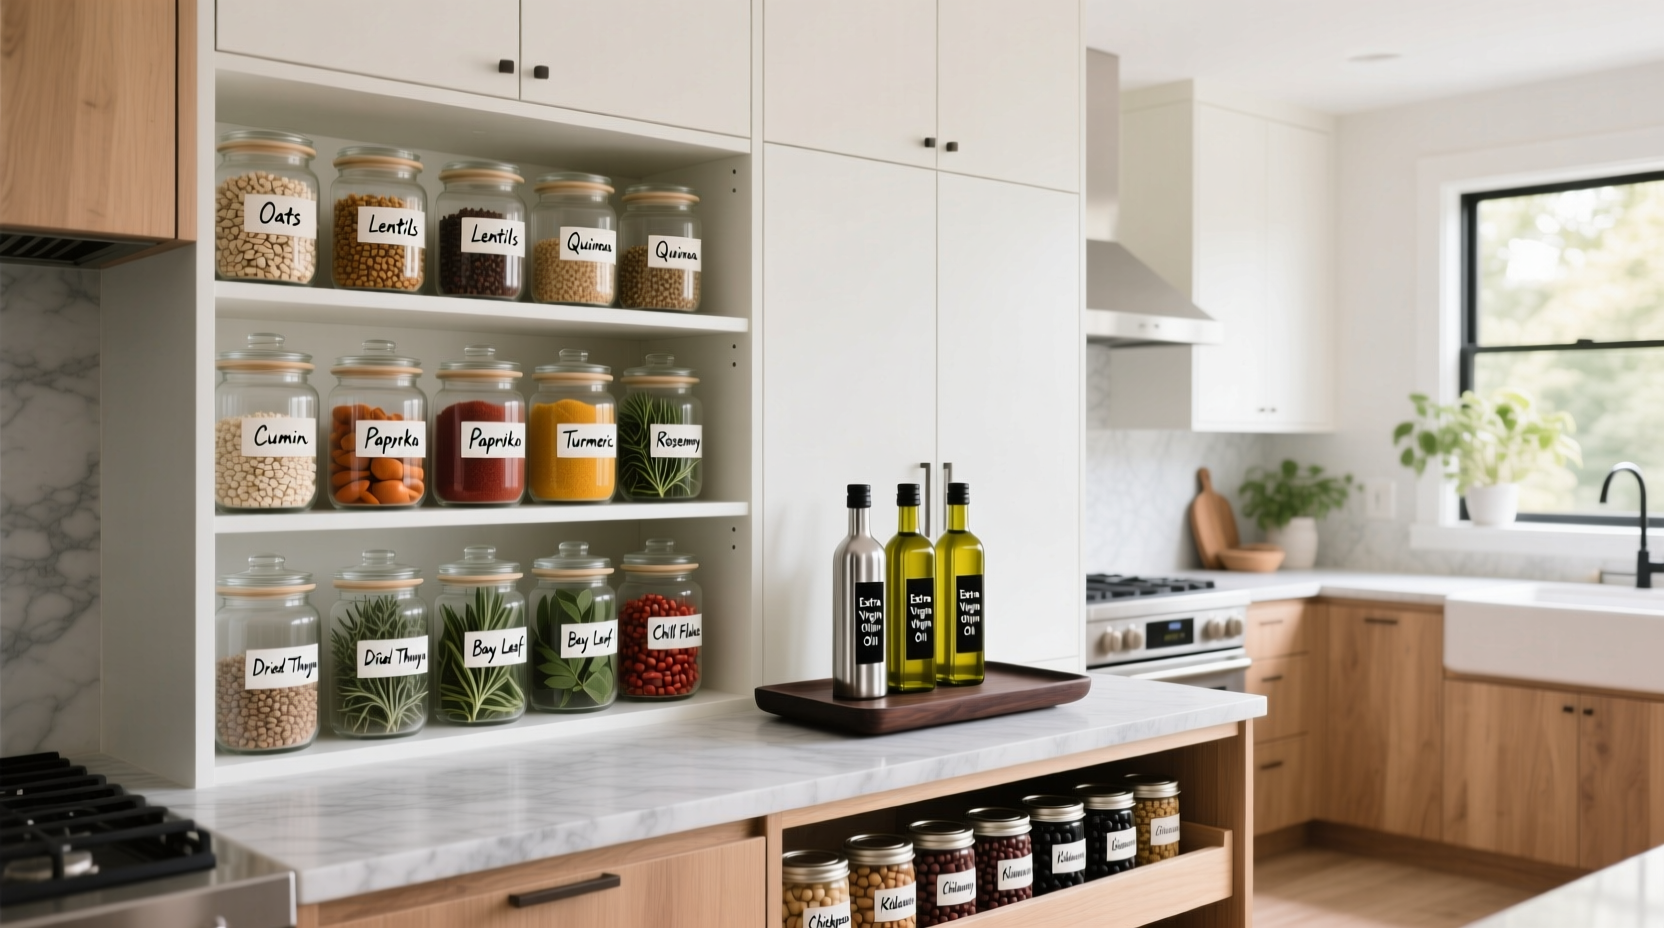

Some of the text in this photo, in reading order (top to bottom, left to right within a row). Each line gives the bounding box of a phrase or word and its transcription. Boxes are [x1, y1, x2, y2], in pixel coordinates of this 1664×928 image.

[259, 201, 301, 227] Oats
[368, 213, 418, 237] Lentils
[470, 223, 519, 247] Lentils
[254, 424, 308, 447] Cumin
[562, 429, 614, 449] Turmeric
[858, 597, 882, 608] Extra
[472, 639, 497, 664] Bay
